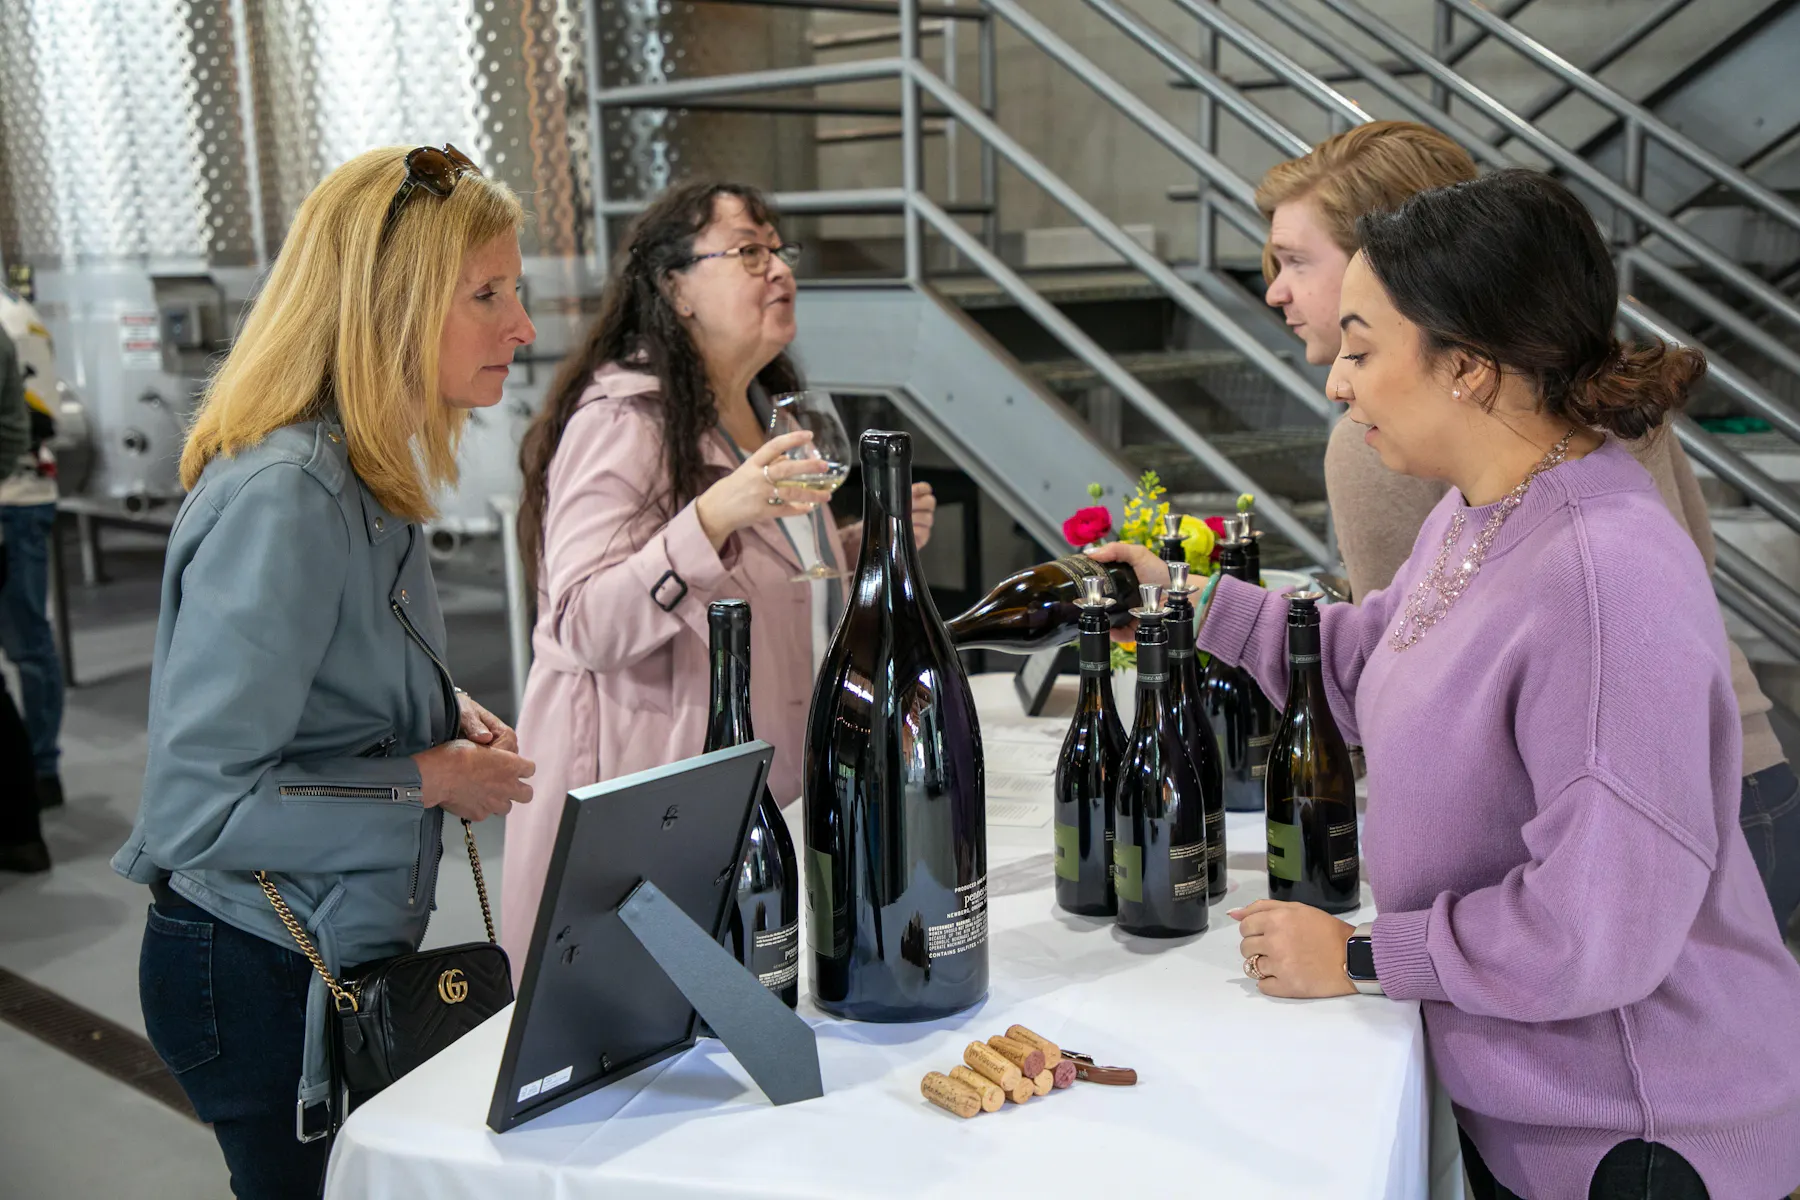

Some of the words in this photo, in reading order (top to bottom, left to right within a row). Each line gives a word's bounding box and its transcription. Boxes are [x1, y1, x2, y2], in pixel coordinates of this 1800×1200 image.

[955, 881, 976, 893] PRODUCED
[929, 923, 954, 932] GOVERNMENT
[929, 938, 950, 946] ALCOHOLIC
[929, 943, 946, 951] OPERATE
[929, 949, 956, 958] CONTAINS
[957, 943, 976, 953] SULFITES
